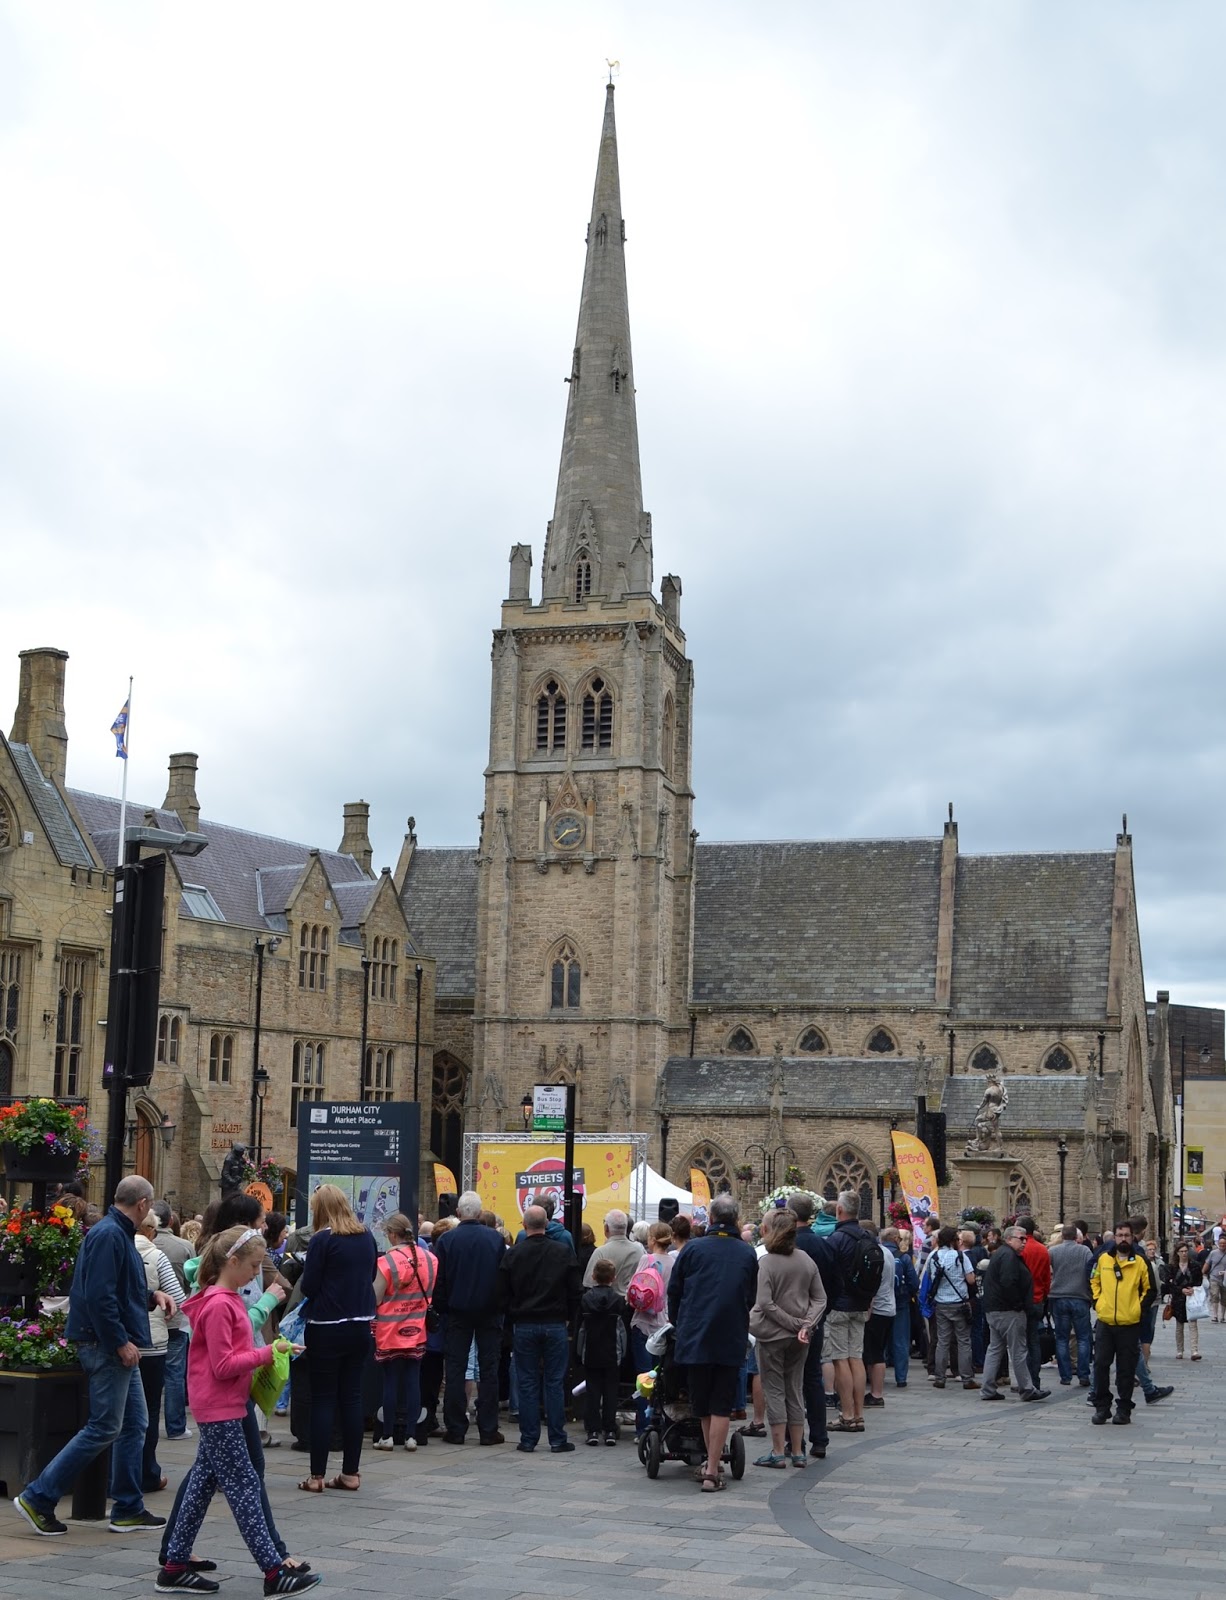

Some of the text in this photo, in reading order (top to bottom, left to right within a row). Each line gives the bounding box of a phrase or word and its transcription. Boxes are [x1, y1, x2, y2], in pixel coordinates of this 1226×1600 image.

[331, 1106, 380, 1114] DURHAM CITY
[520, 1173, 563, 1185] STREETS
